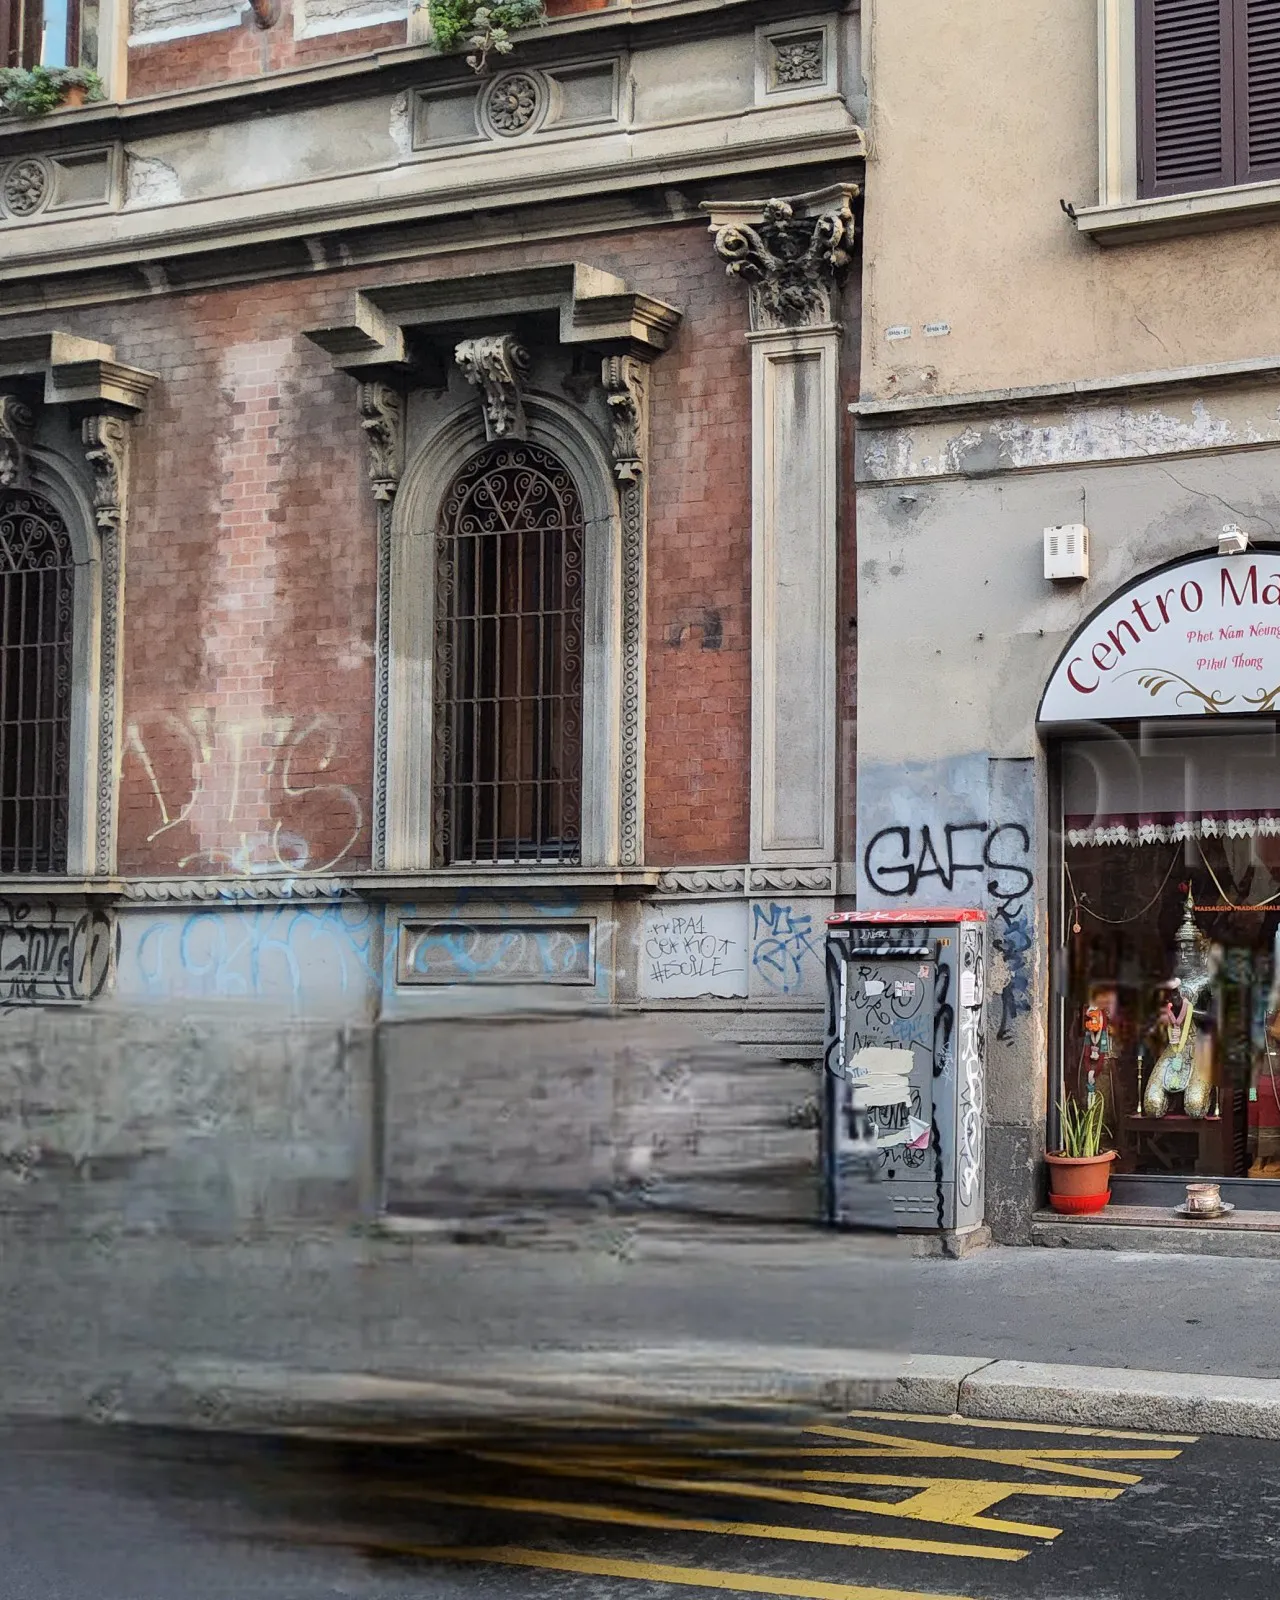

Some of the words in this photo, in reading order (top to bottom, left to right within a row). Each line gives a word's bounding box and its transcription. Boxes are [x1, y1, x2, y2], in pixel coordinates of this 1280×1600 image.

[1066, 580, 1203, 694] Centro
[1218, 624, 1244, 640] Nam
[1231, 652, 1264, 671] Thong
